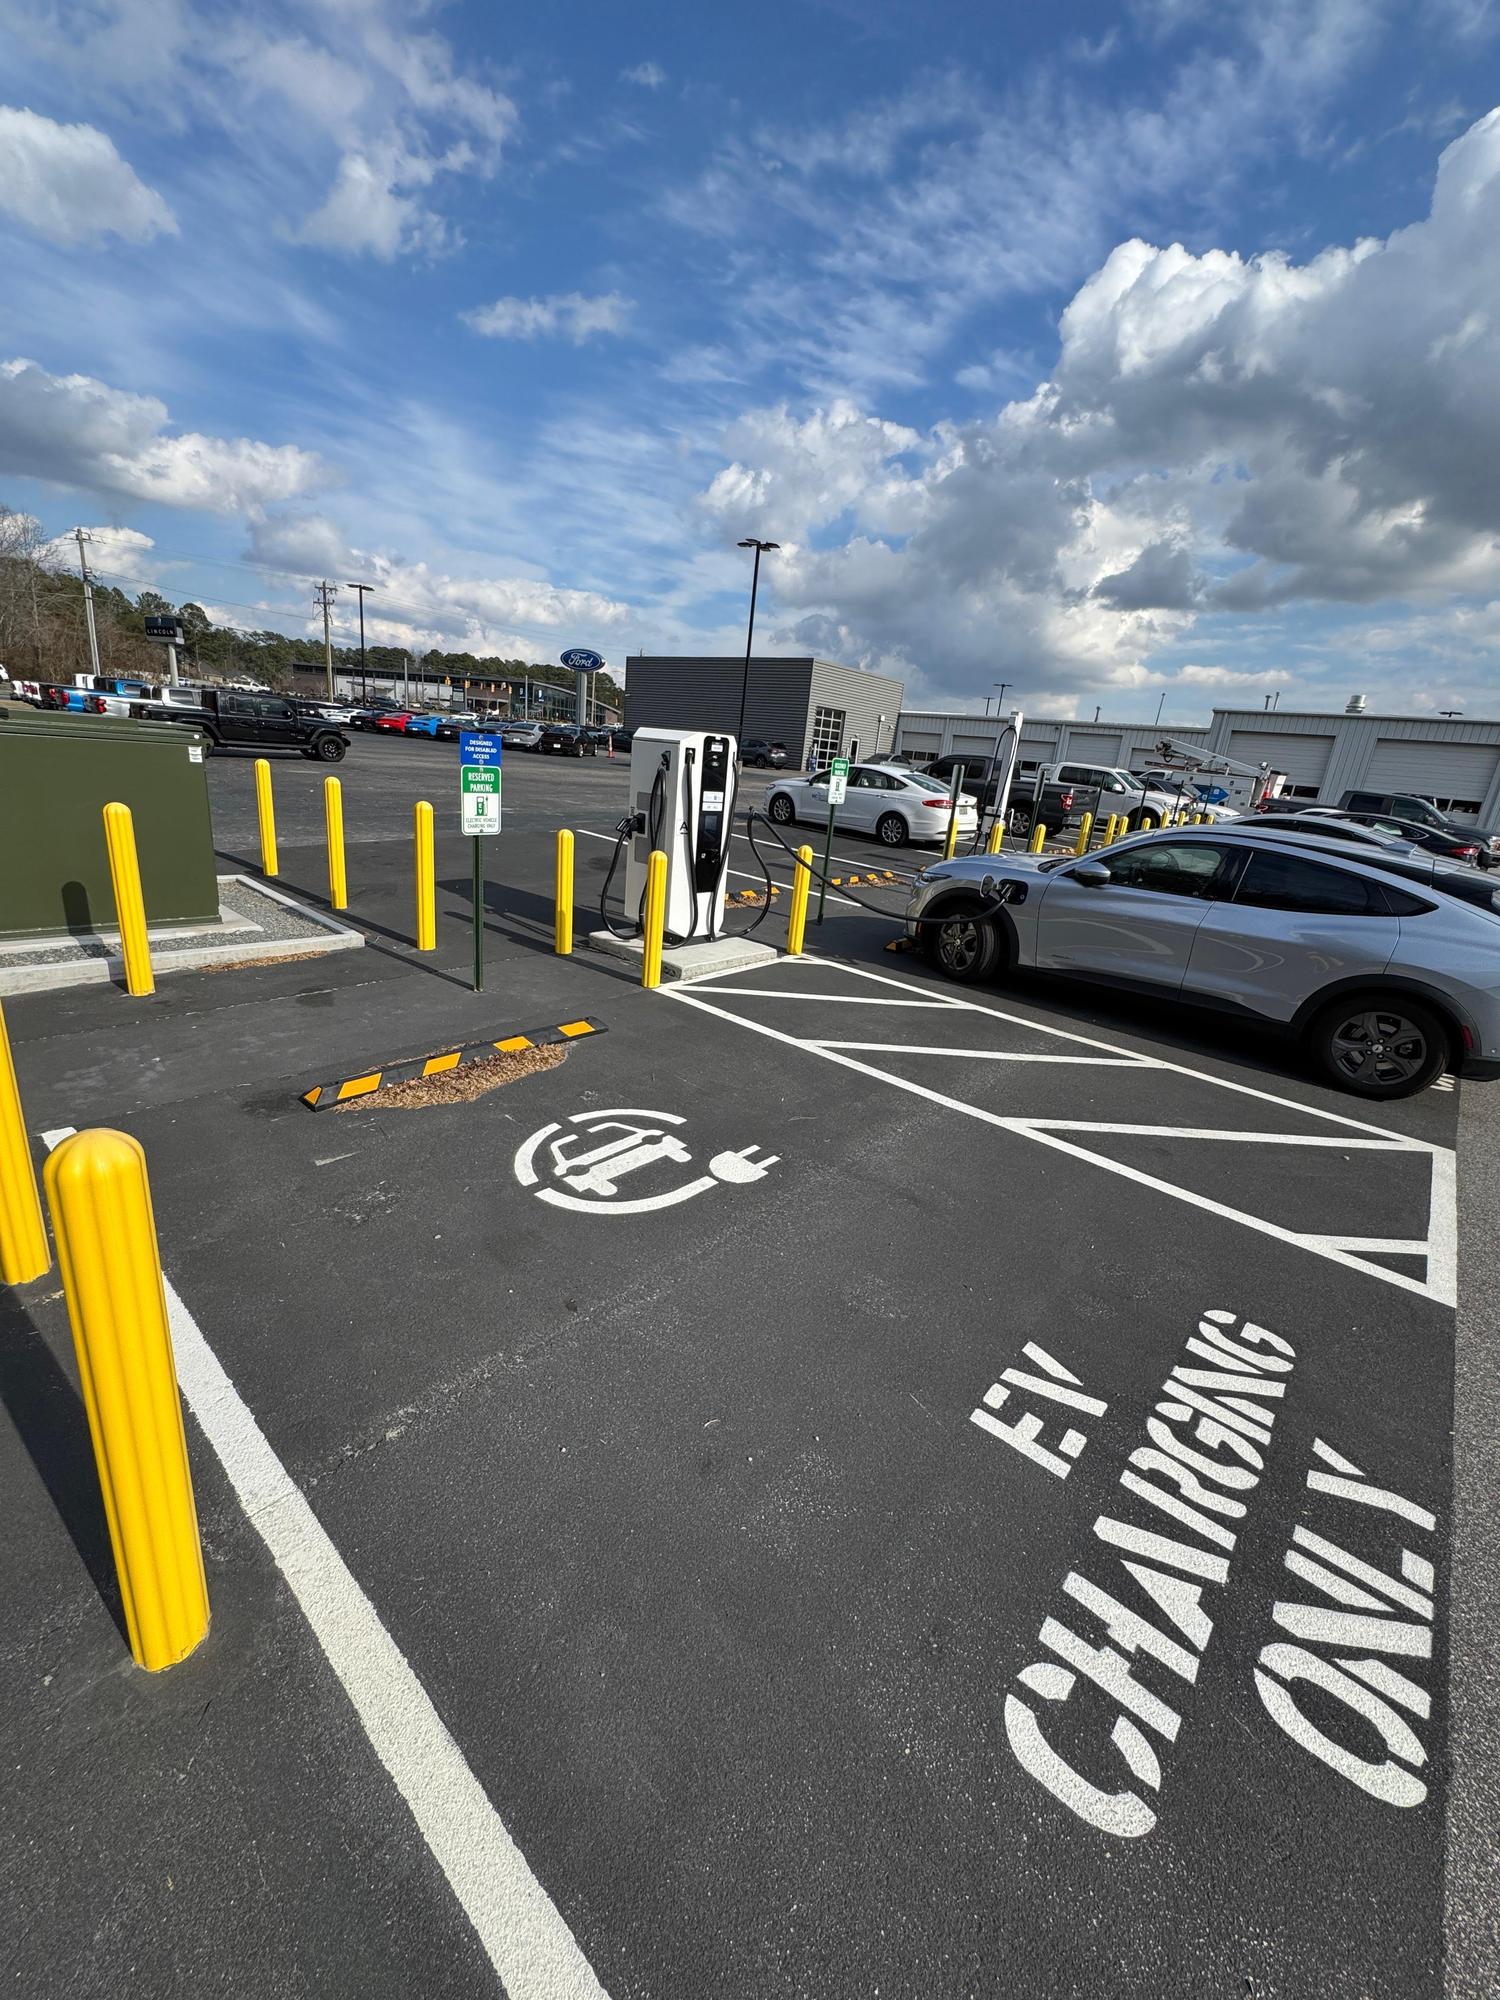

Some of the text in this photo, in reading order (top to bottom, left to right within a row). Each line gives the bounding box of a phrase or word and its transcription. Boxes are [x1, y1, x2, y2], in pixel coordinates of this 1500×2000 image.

[568, 653, 594, 667] Ford
[468, 772, 495, 782] RESERVED
[470, 784, 493, 792] PARKING
[680, 820, 688, 831] A
[969, 1341, 1108, 1480] EV
[1003, 1309, 1296, 1838] CHARGING
[1253, 1437, 1437, 1808] ONLY
